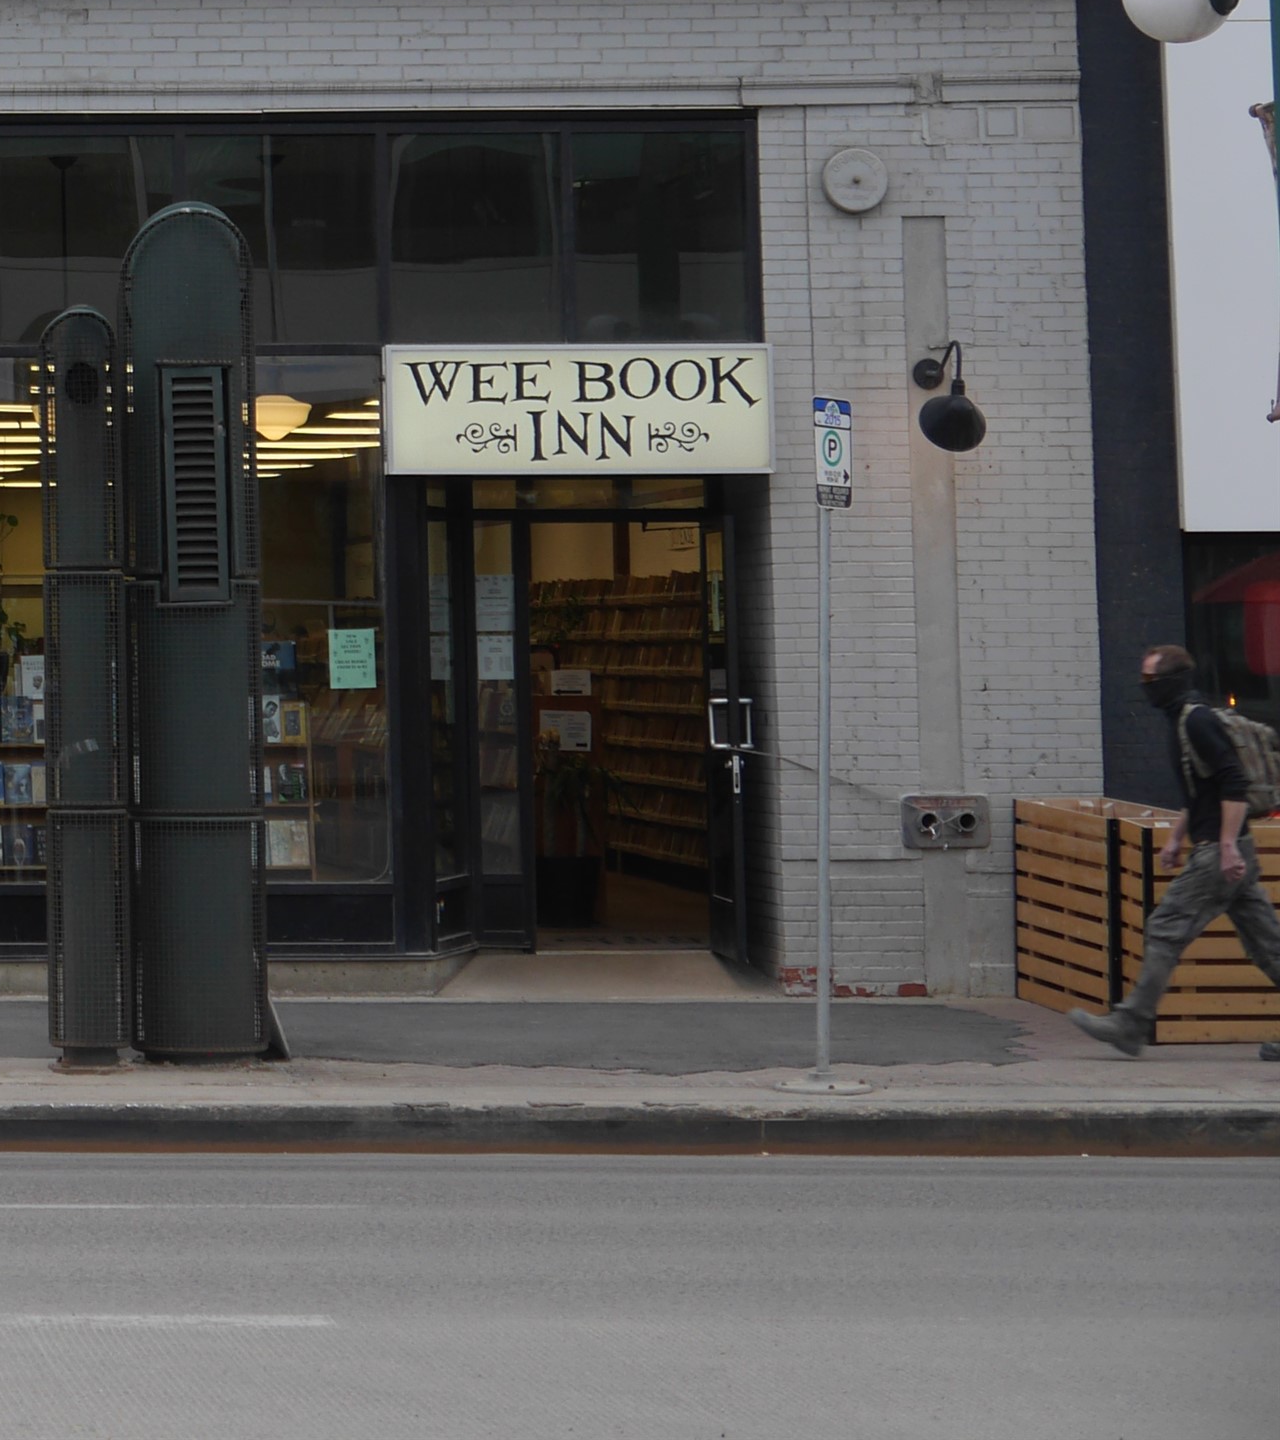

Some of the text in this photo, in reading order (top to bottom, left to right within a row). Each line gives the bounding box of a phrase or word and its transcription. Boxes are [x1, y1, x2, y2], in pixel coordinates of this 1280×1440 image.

[403, 356, 762, 408] WEE BOOK
[526, 409, 637, 462] INN
[827, 438, 838, 458] P
